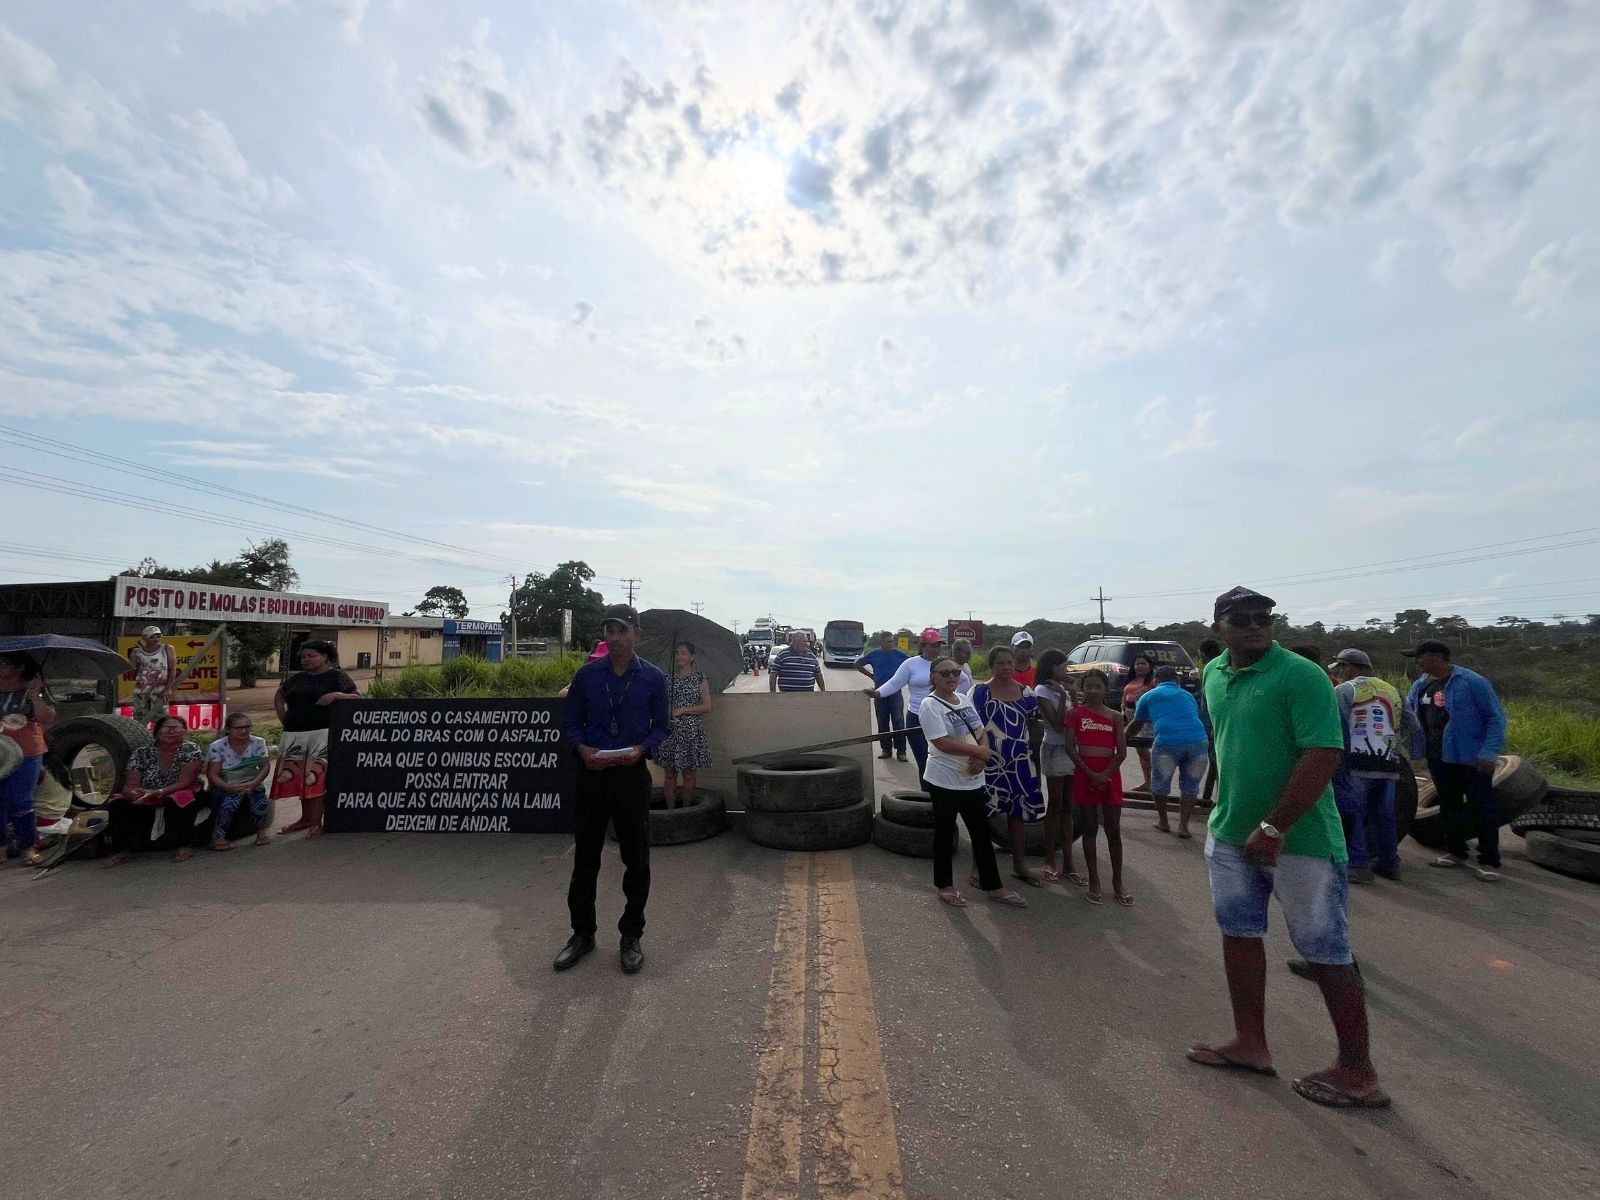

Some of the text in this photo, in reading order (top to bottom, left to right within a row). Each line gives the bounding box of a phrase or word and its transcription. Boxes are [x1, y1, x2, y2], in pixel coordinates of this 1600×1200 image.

[124, 585, 184, 609] POSTO
[188, 590, 207, 610] DE
[209, 592, 257, 613] MOLAS
[259, 597, 265, 614] E
[267, 598, 335, 617] BORRACHARIA
[1143, 649, 1178, 662] PRF
[353, 711, 550, 725] QUEREMOS O CASAMENTO DO
[341, 729, 560, 742] RAMAL DO BRAS COM O ASFALTO
[357, 752, 557, 768] PARA QUE O ONIBUS ESCOLAR
[405, 773, 508, 789] POSSA ENTRAR
[337, 792, 560, 812] PARA QUE AS CRIANÇAS NA LAMA
[386, 815, 510, 831] DEIXEM DE ANDAR.
